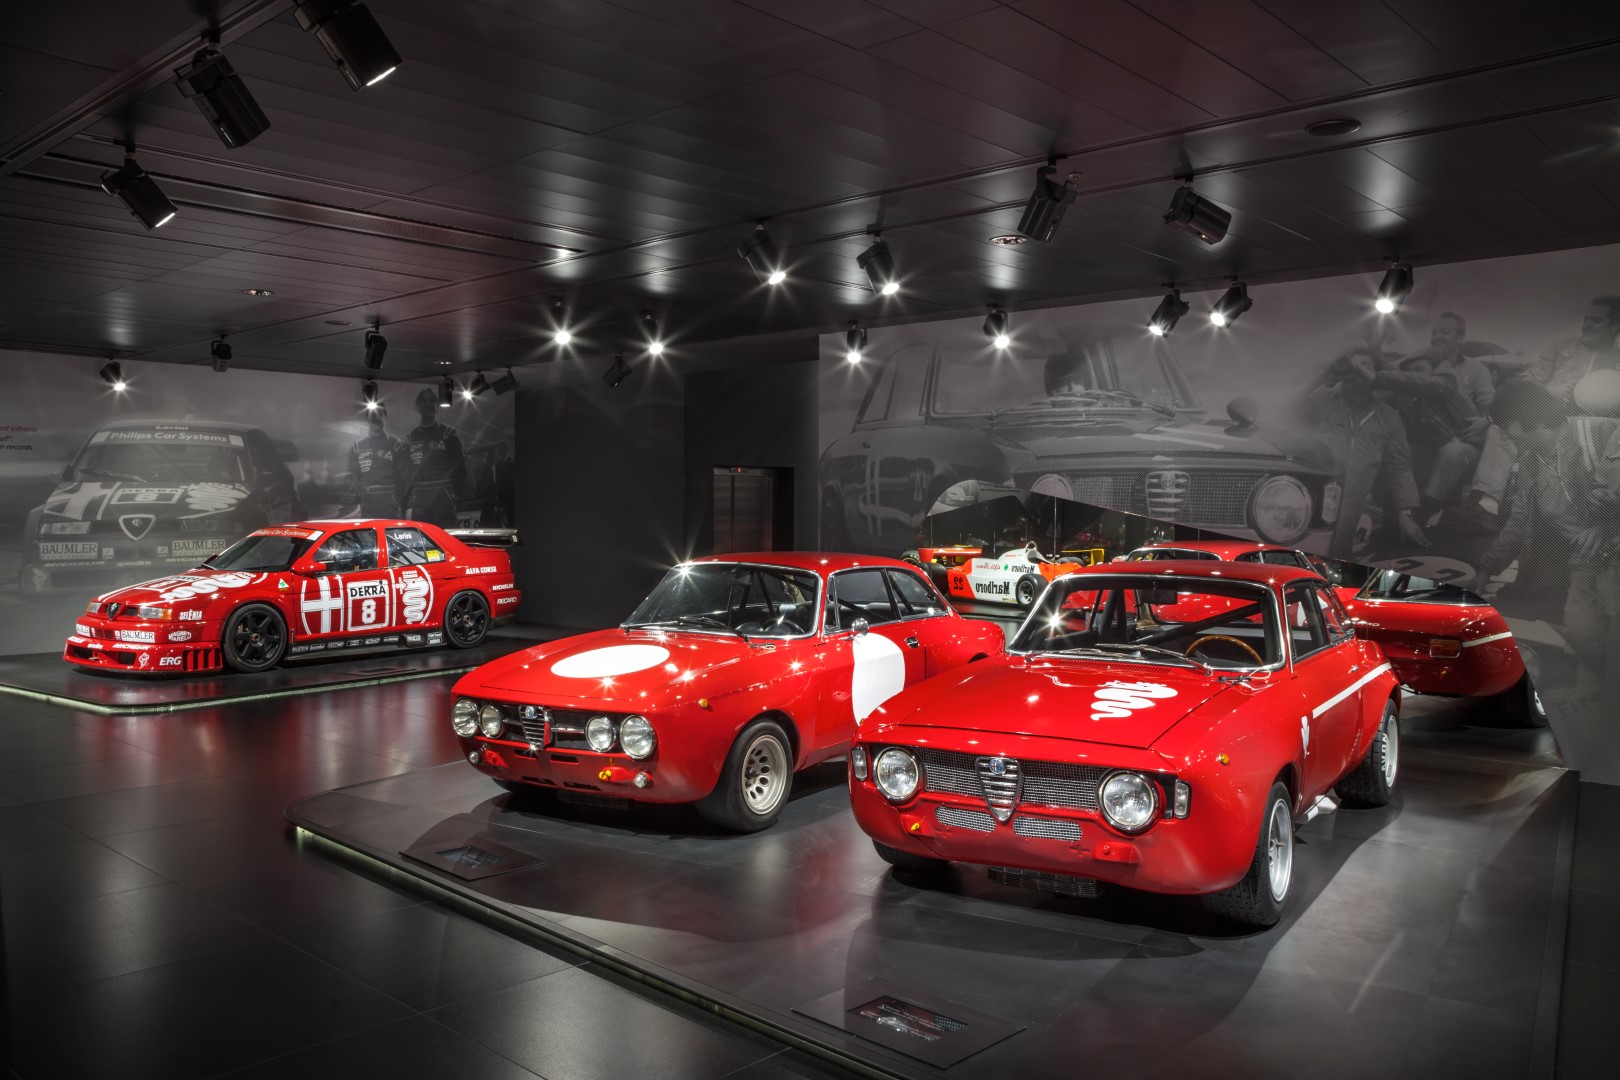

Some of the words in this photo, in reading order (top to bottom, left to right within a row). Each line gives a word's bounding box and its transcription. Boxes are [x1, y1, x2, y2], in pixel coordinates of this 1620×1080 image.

[110, 432, 152, 440] Philips
[154, 432, 177, 440] Car
[178, 432, 228, 442] Systems
[394, 532, 413, 540] Larini
[465, 567, 480, 575] ALFA
[480, 566, 497, 574] CORSE
[350, 585, 386, 597] DEKRA
[492, 583, 514, 591] MICHELIN
[497, 596, 517, 605] RECARO
[361, 598, 377, 625] 8
[159, 656, 182, 666] ERG
